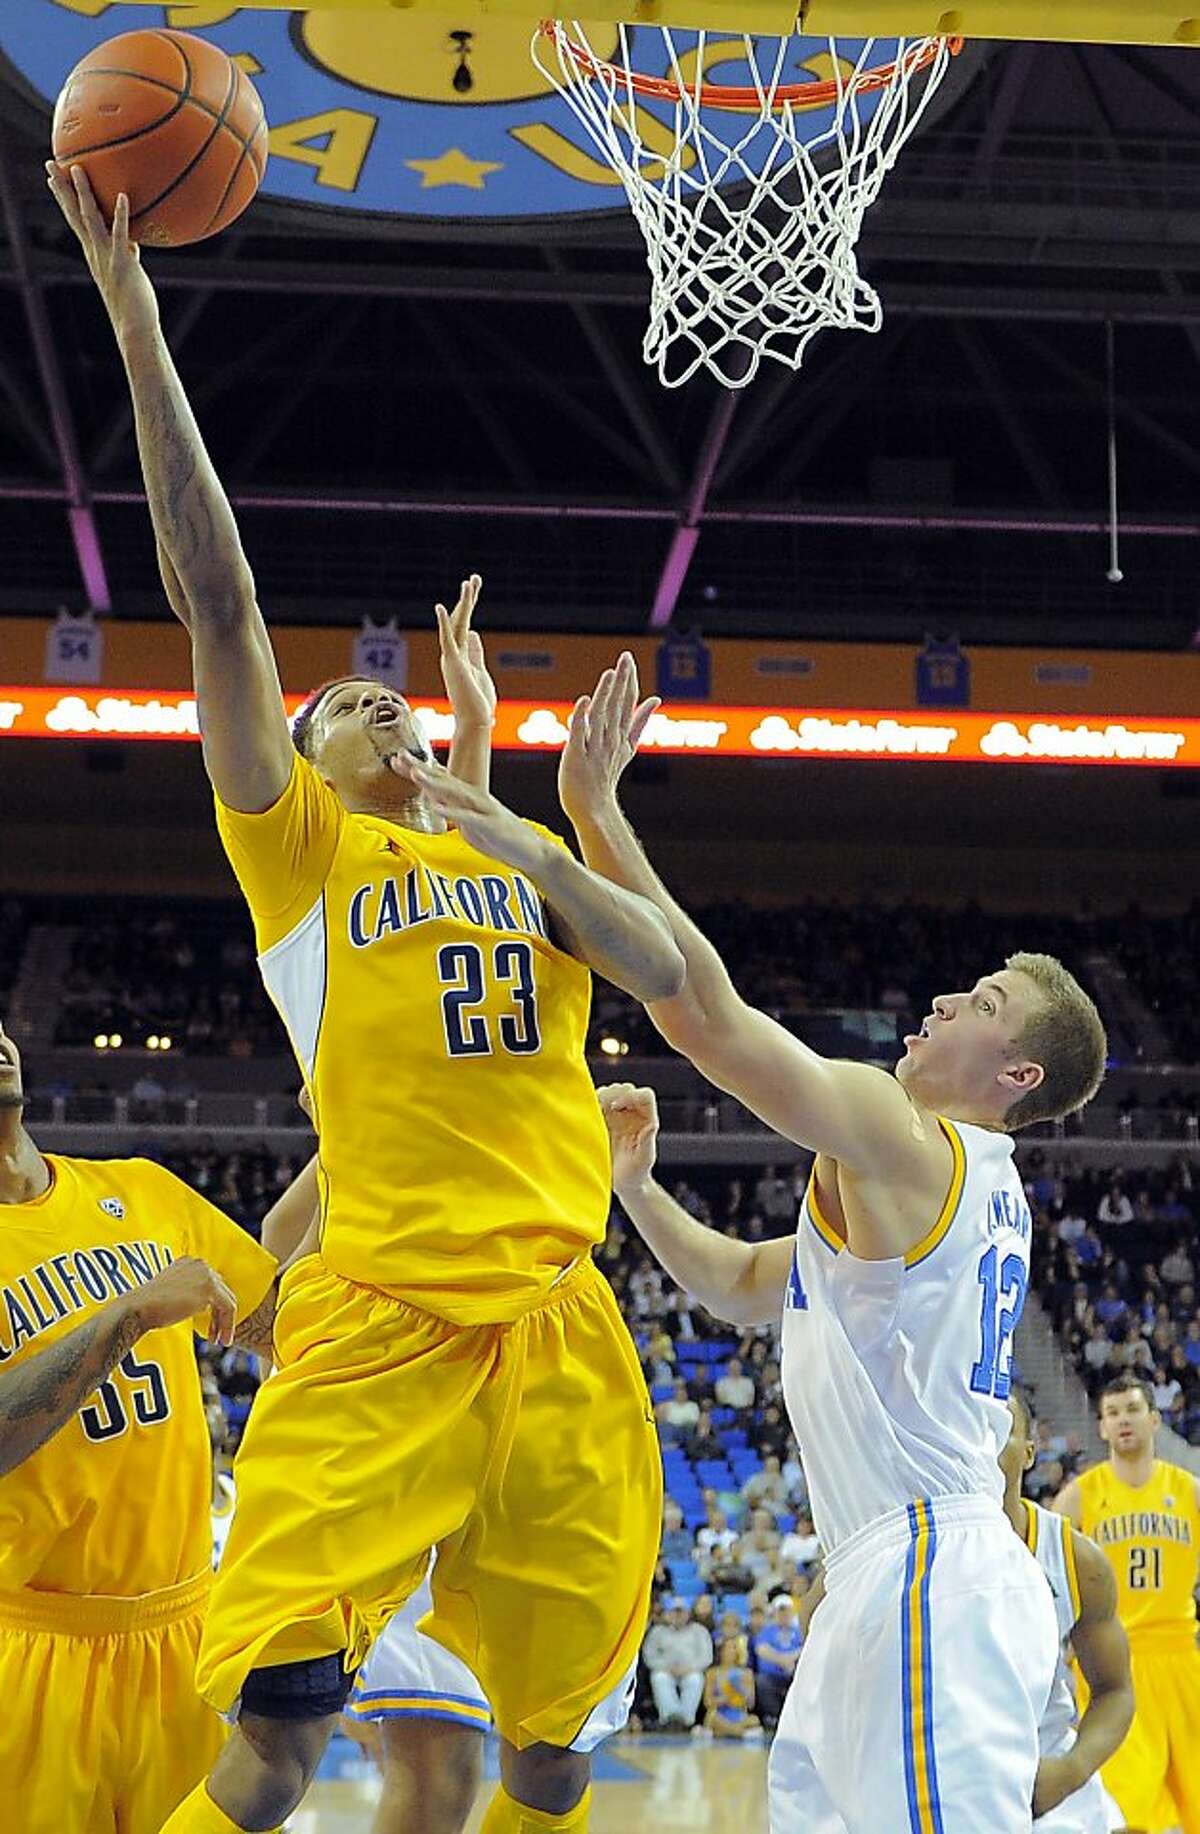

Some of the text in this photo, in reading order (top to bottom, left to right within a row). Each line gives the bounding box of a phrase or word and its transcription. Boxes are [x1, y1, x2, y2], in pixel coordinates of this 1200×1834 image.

[365, 648, 395, 670] 42
[349, 865, 549, 948] CALIFORN
[437, 942, 542, 1056] 23
[0, 1240, 176, 1363] ALIFORNI
[970, 1244, 1029, 1400] 12
[1092, 1511, 1192, 1546] CALIFORNIA
[1129, 1547, 1162, 1590] 21
